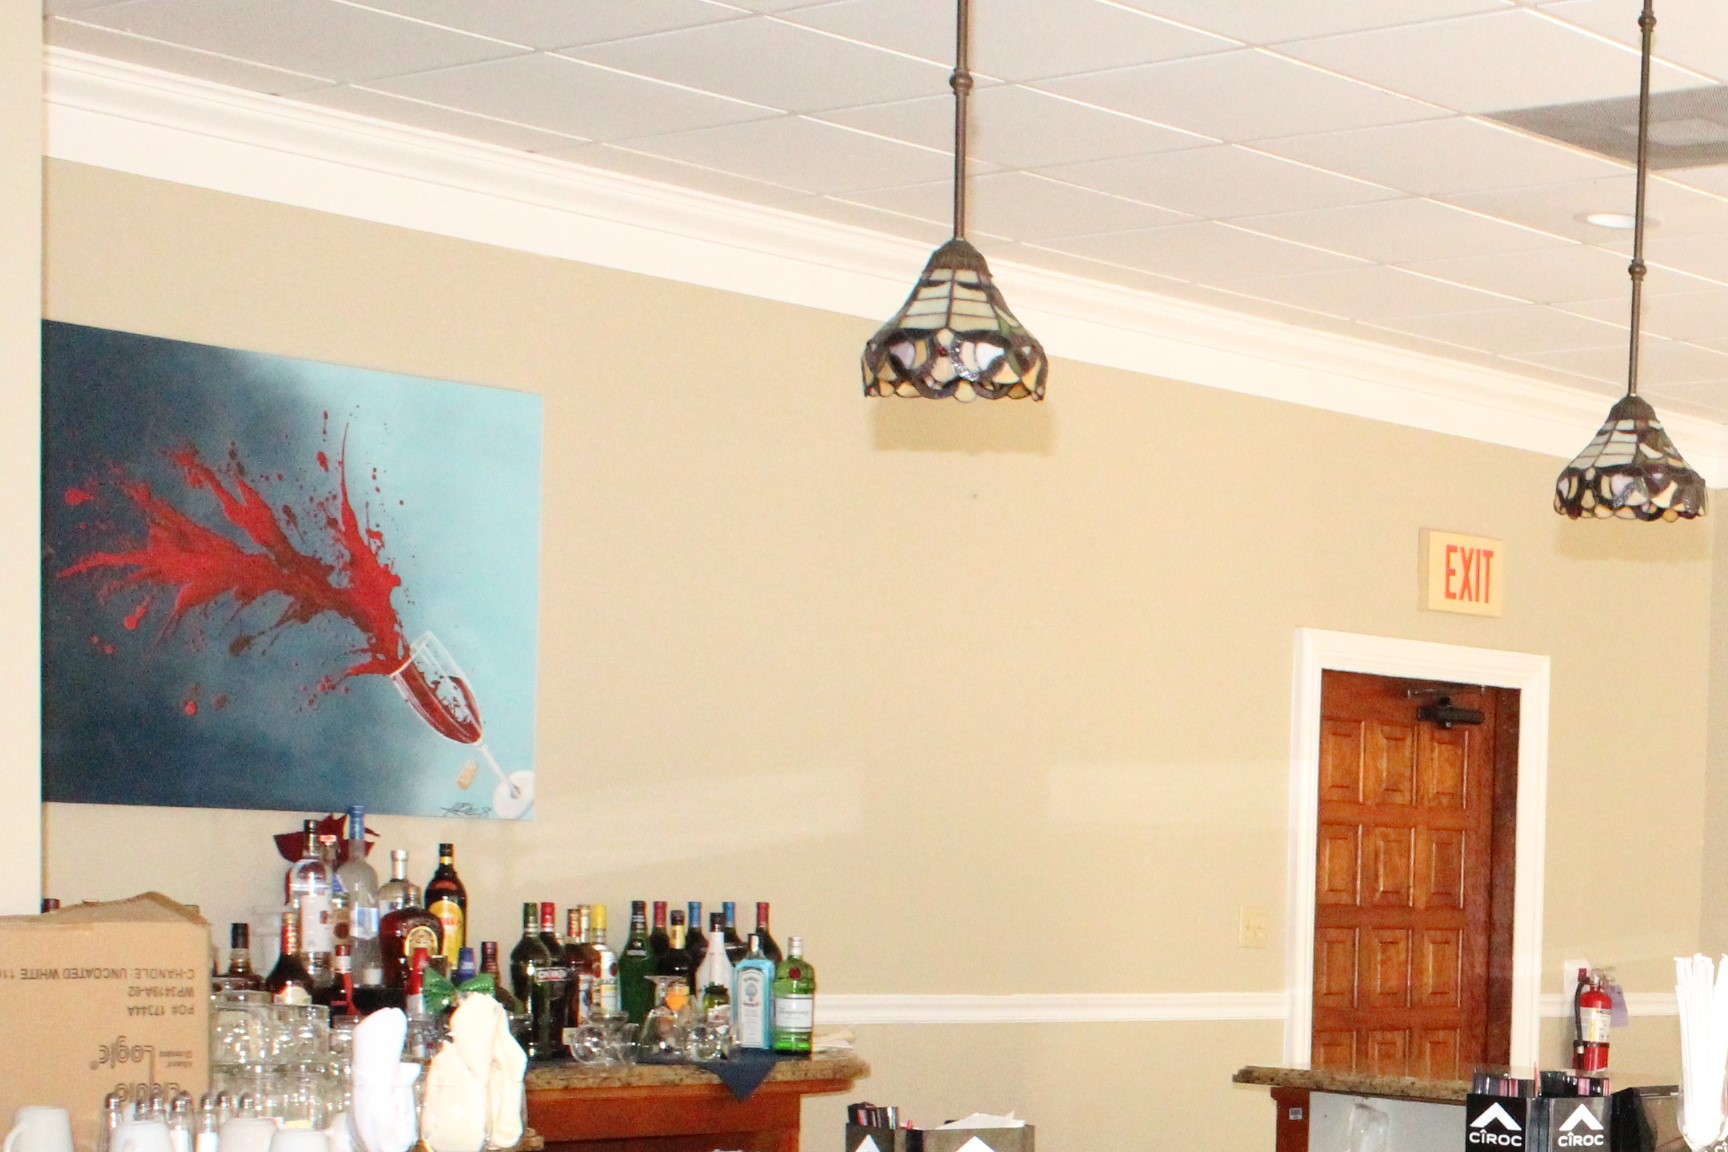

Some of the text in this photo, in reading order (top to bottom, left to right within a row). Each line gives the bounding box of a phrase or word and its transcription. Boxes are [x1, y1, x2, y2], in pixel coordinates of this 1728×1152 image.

[1445, 544, 1494, 604] EXIT
[20, 968, 60, 980] WHITE
[63, 968, 128, 980] UNCOATED
